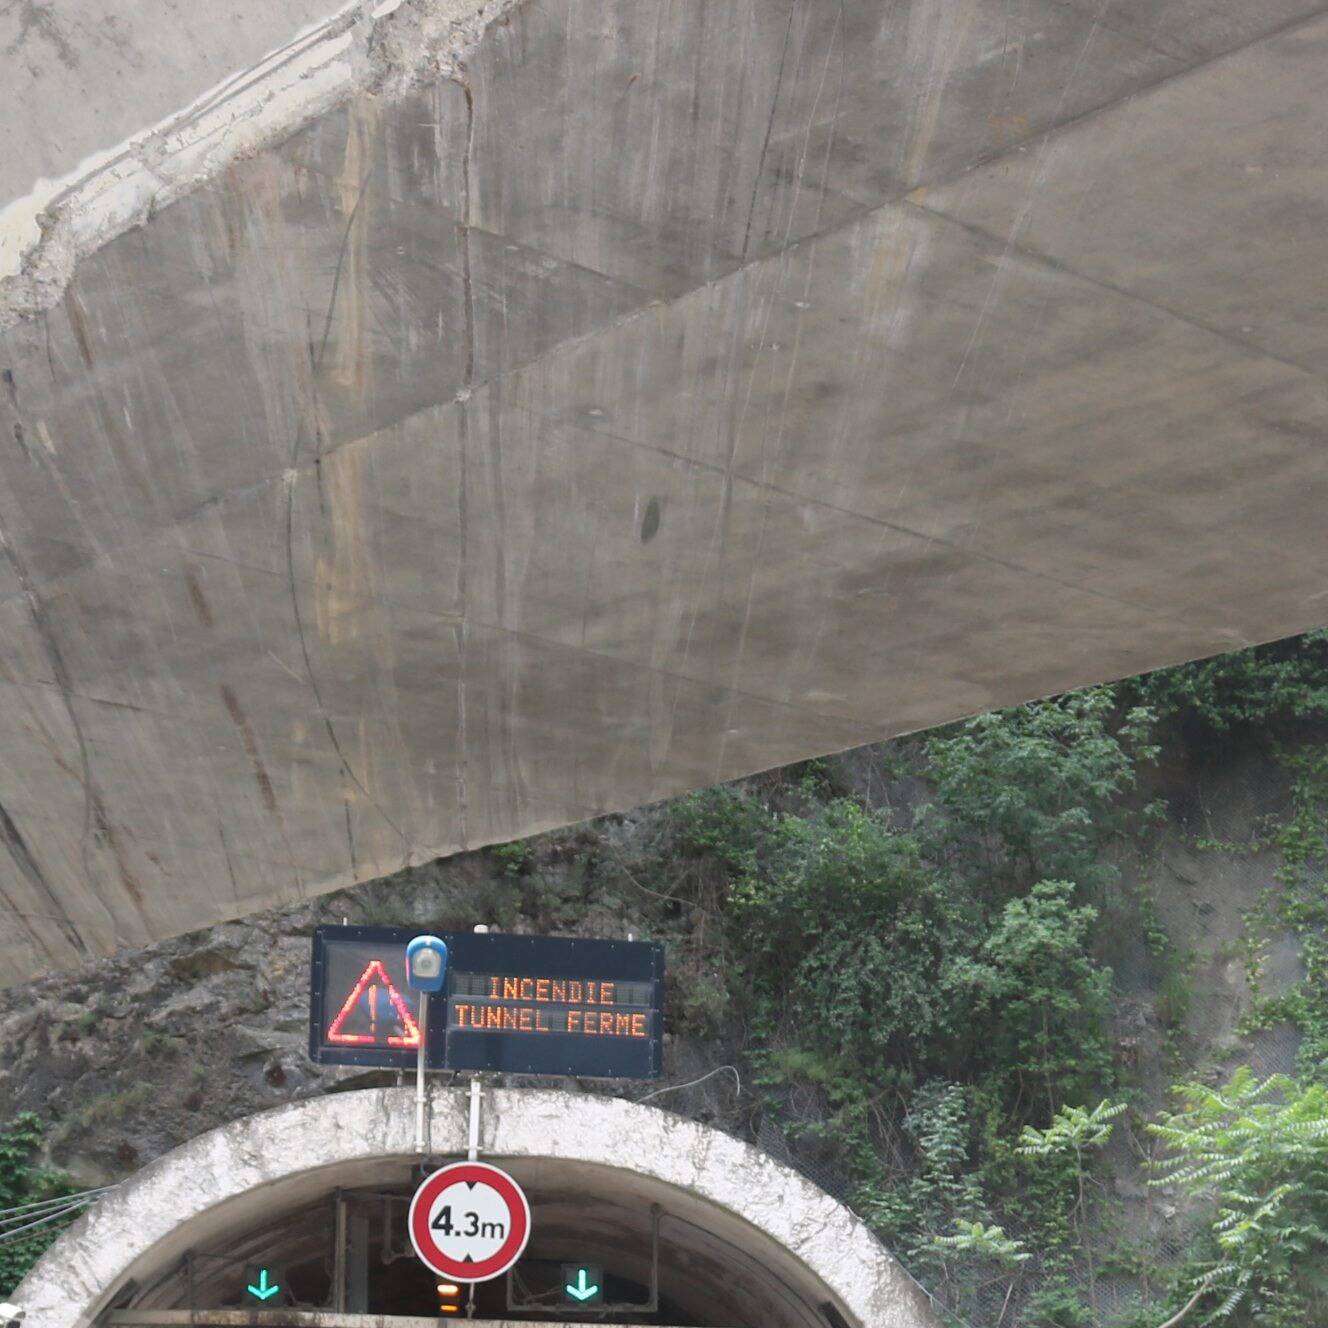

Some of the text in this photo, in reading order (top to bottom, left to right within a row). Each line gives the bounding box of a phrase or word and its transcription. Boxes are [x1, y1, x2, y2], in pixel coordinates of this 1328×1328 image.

[490, 976, 615, 1005] INCENDIE
[455, 1004, 647, 1037] TUNNEL FERME
[432, 1205, 505, 1239] 4.3m
